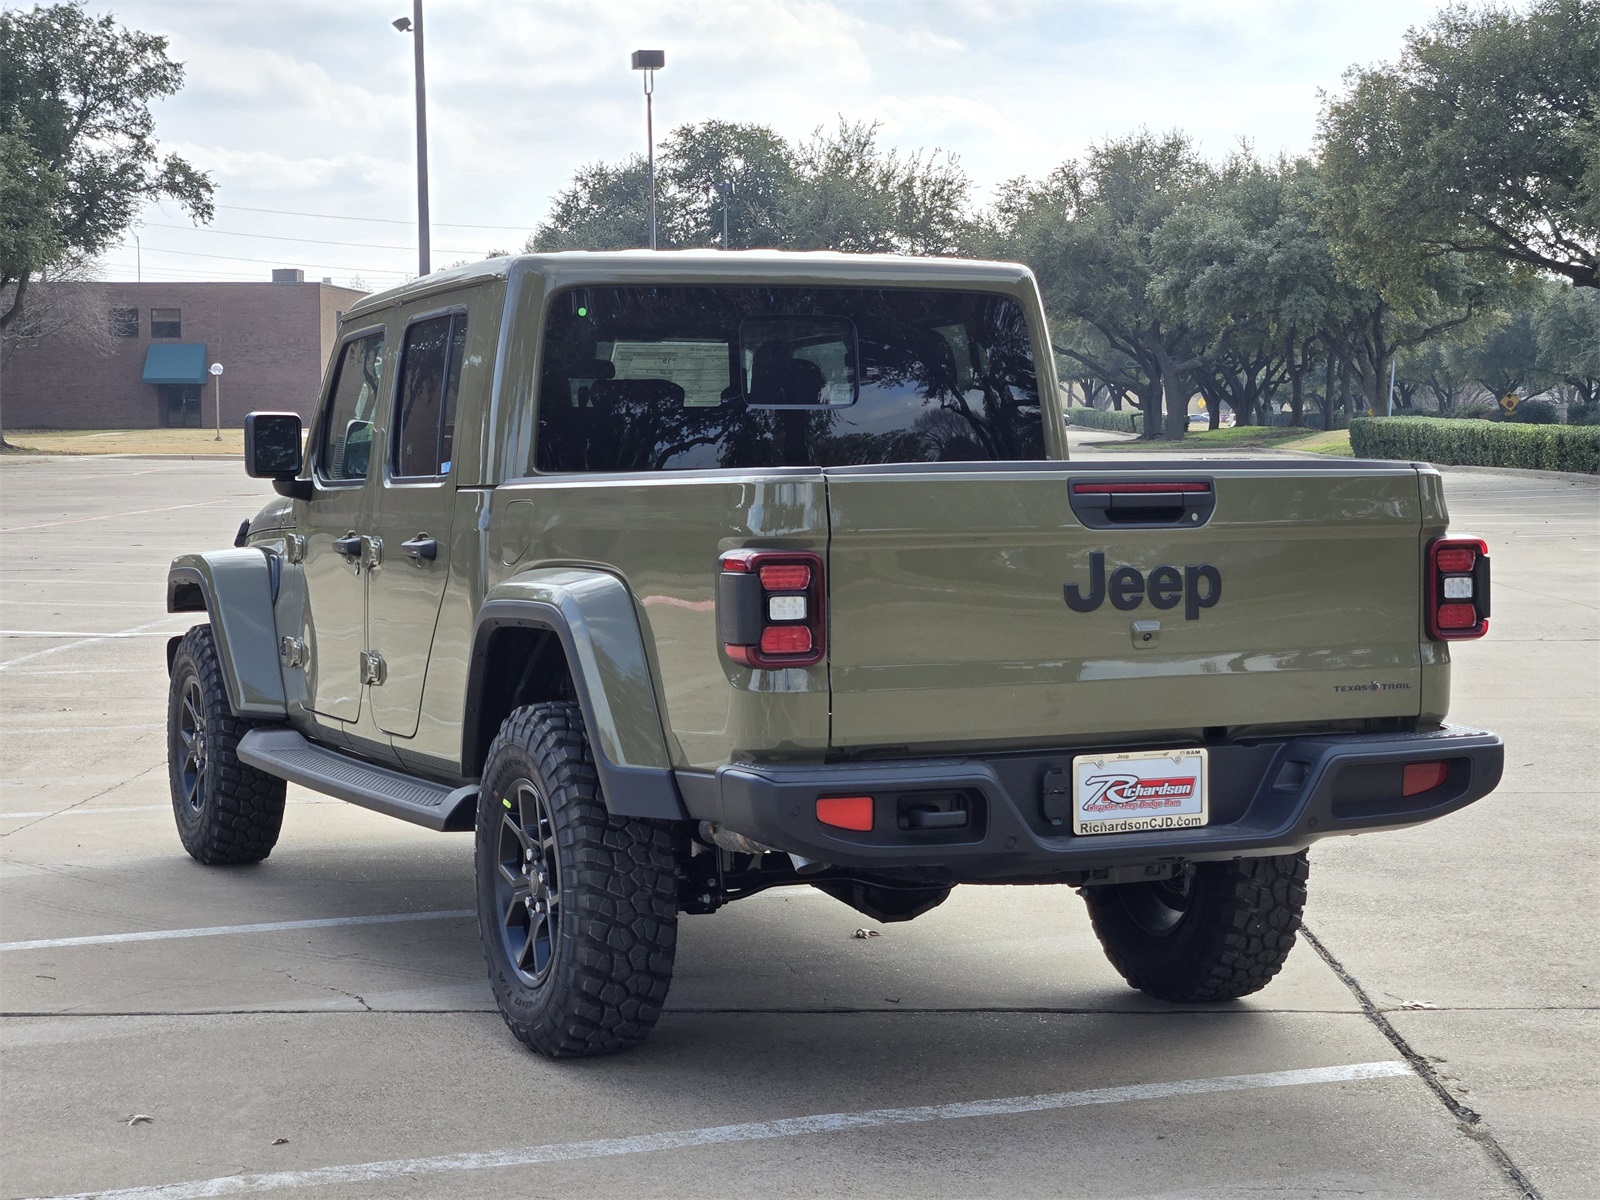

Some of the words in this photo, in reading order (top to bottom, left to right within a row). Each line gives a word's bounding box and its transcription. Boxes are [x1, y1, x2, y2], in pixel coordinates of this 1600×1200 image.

[1064, 552, 1222, 621] Jeep
[1082, 774, 1191, 811] Richardson
[1080, 817, 1201, 834] RichardsonCJD.com
